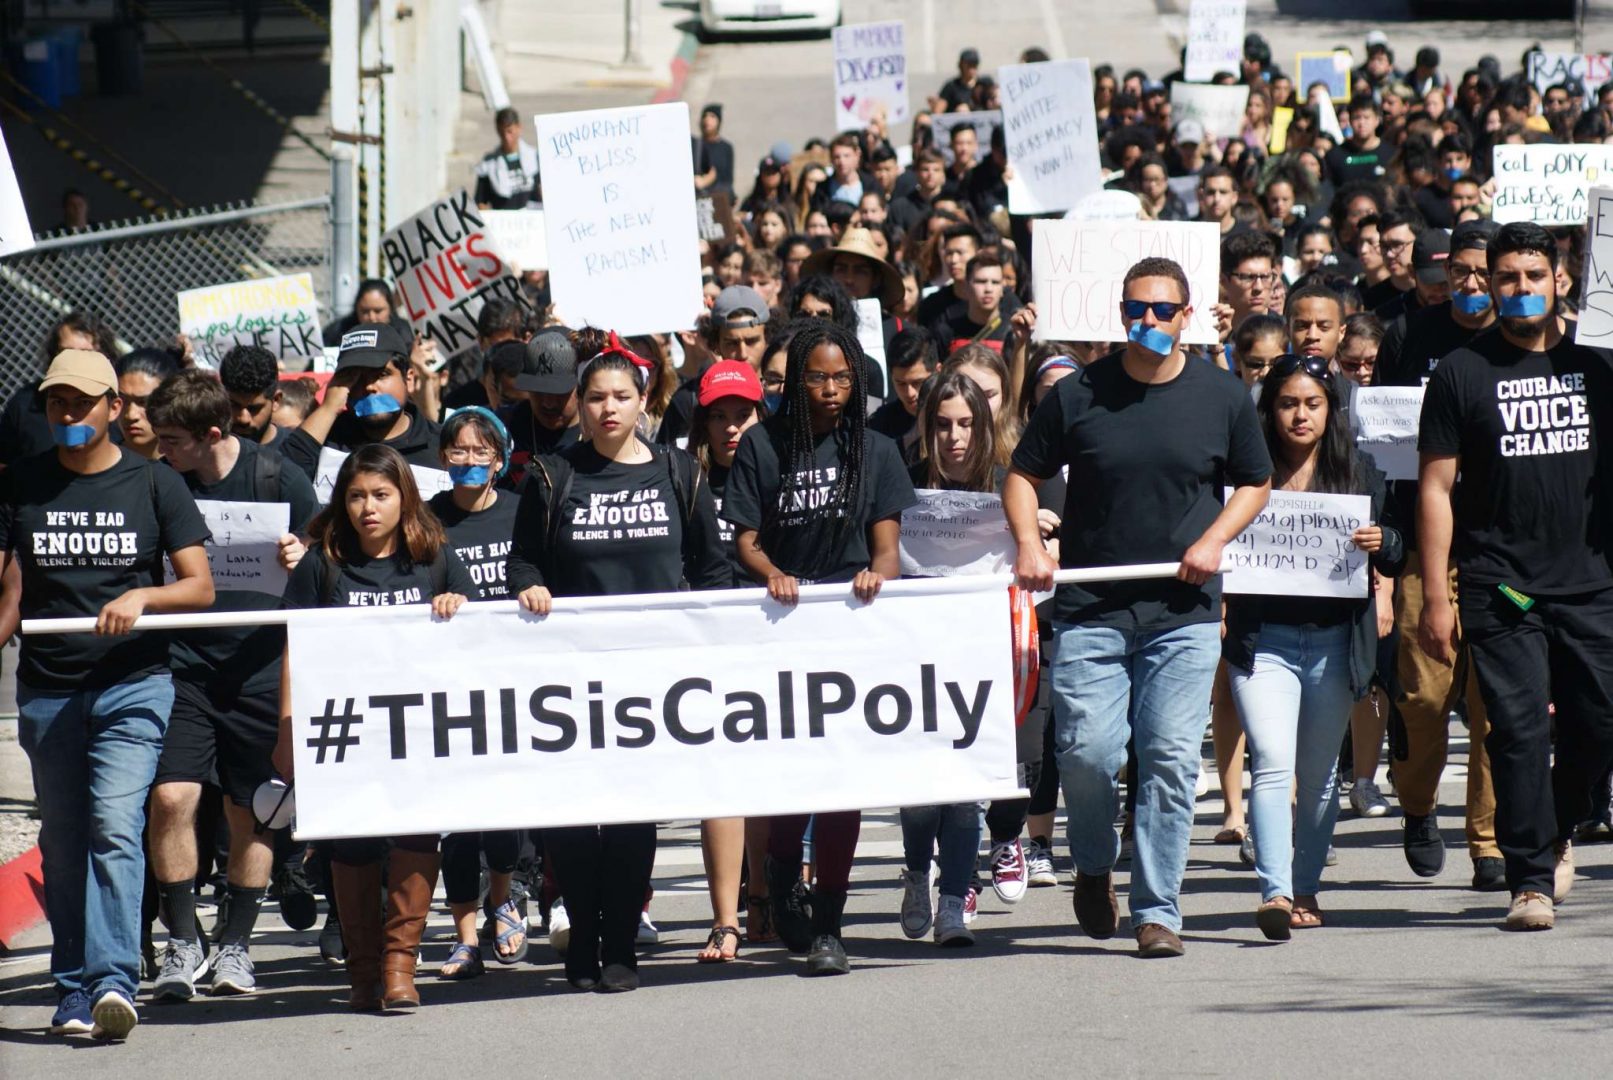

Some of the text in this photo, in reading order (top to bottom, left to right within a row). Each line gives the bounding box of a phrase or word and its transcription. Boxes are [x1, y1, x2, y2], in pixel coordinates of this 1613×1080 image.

[1006, 72, 1041, 103] END
[1008, 94, 1058, 132] WHITE
[578, 146, 637, 175] BLISS
[603, 182, 619, 204] IS
[610, 207, 655, 233] NEW
[383, 190, 484, 277] BLACK
[1045, 229, 1204, 275] WE STAND
[399, 233, 505, 322] LIVES
[1044, 279, 1205, 333] TOGER
[188, 309, 311, 343] apologies
[1497, 372, 1586, 400] COURAGE
[1360, 395, 1379, 406] Ask
[1360, 416, 1412, 426] What was
[1498, 395, 1590, 433] VOICE
[1500, 428, 1590, 457] CHANGE
[590, 489, 659, 507] WE'VE HAD
[46, 511, 125, 527] WE'VE HAD
[220, 511, 252, 522] IS A
[572, 502, 669, 526] ENOUGH
[961, 515, 980, 525] the
[32, 532, 138, 555] ENOUGH
[572, 526, 669, 541] SILENCE IS VIOLENCE
[922, 529, 932, 538] in
[936, 530, 967, 540] 2016
[1271, 533, 1323, 550] color
[36, 557, 137, 567] SILENCE IS VIOLENCE
[1305, 556, 1318, 570] a
[1331, 558, 1360, 585] As
[348, 587, 421, 606] WE'VE HAD
[305, 662, 994, 766] #THISisCalPoly
